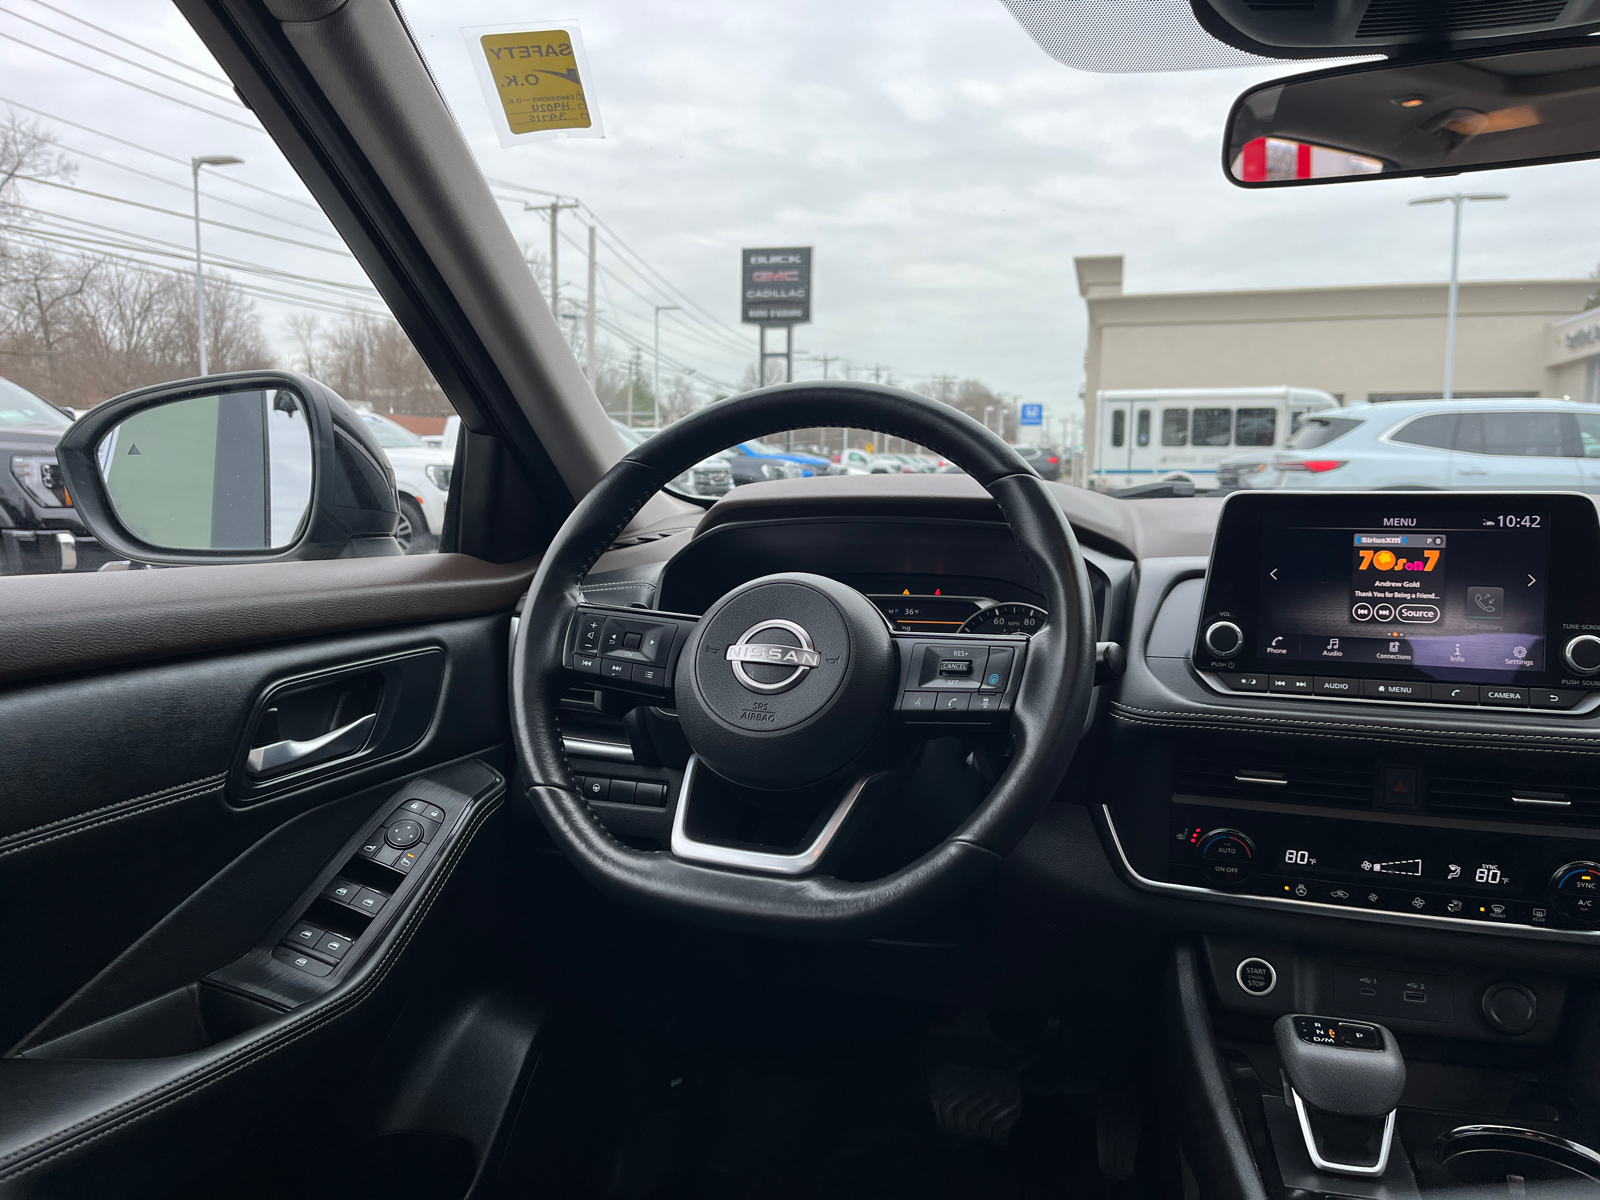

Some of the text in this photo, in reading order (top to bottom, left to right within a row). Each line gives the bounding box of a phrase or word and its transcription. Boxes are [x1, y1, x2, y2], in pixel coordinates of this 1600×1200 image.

[750, 254, 801, 264] BUICK
[752, 271, 799, 282] GMC
[746, 288, 805, 298] CADILLAC
[1383, 517, 1416, 527] MENU
[1497, 515, 1541, 528] 10:42
[1374, 580, 1402, 588] Andrew
[1401, 608, 1434, 618] Source
[993, 617, 1005, 625] 60
[1023, 618, 1035, 626] 80
[1479, 624, 1504, 632] History
[728, 646, 819, 666] NISSAN
[1376, 652, 1412, 660] Connections
[942, 662, 967, 670] CANCEL
[1505, 658, 1534, 666] Settings
[1324, 682, 1348, 690] AUDIO
[1388, 686, 1412, 694] MENU
[1488, 691, 1521, 699] CAMERA
[752, 702, 768, 710] SRS
[740, 711, 776, 722] AIRBAG
[1481, 863, 1499, 871] SYNC
[1576, 881, 1596, 890] SYNC
[1577, 899, 1593, 907] A/C
